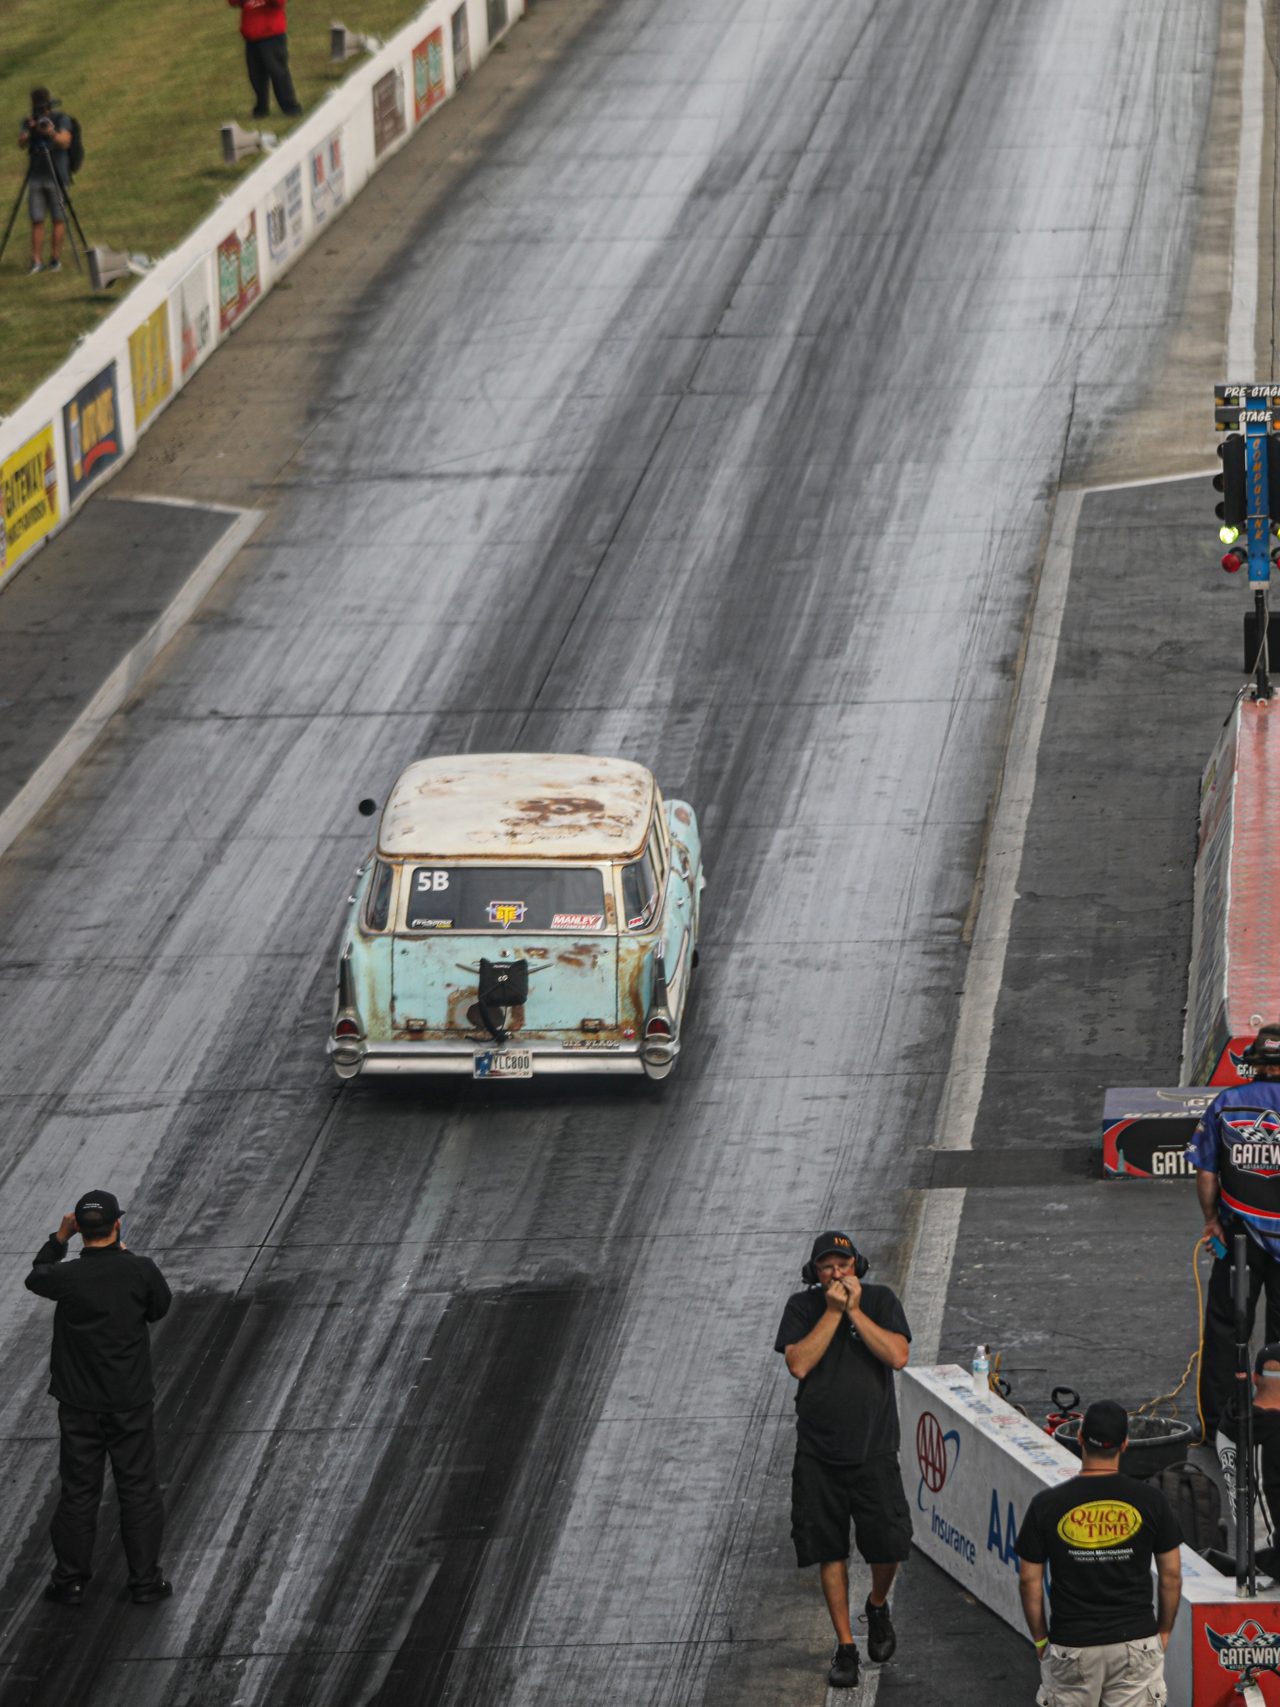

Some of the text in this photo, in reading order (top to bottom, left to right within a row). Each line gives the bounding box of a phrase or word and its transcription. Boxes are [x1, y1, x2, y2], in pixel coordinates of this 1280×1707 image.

[1238, 411, 1272, 422] STAGE
[417, 870, 449, 892] 5B
[1070, 1508, 1131, 1527] QUICK
[931, 1505, 977, 1565] Insurance
[1085, 1523, 1131, 1538] TIME
[1219, 1647, 1280, 1665] GATEWAY
